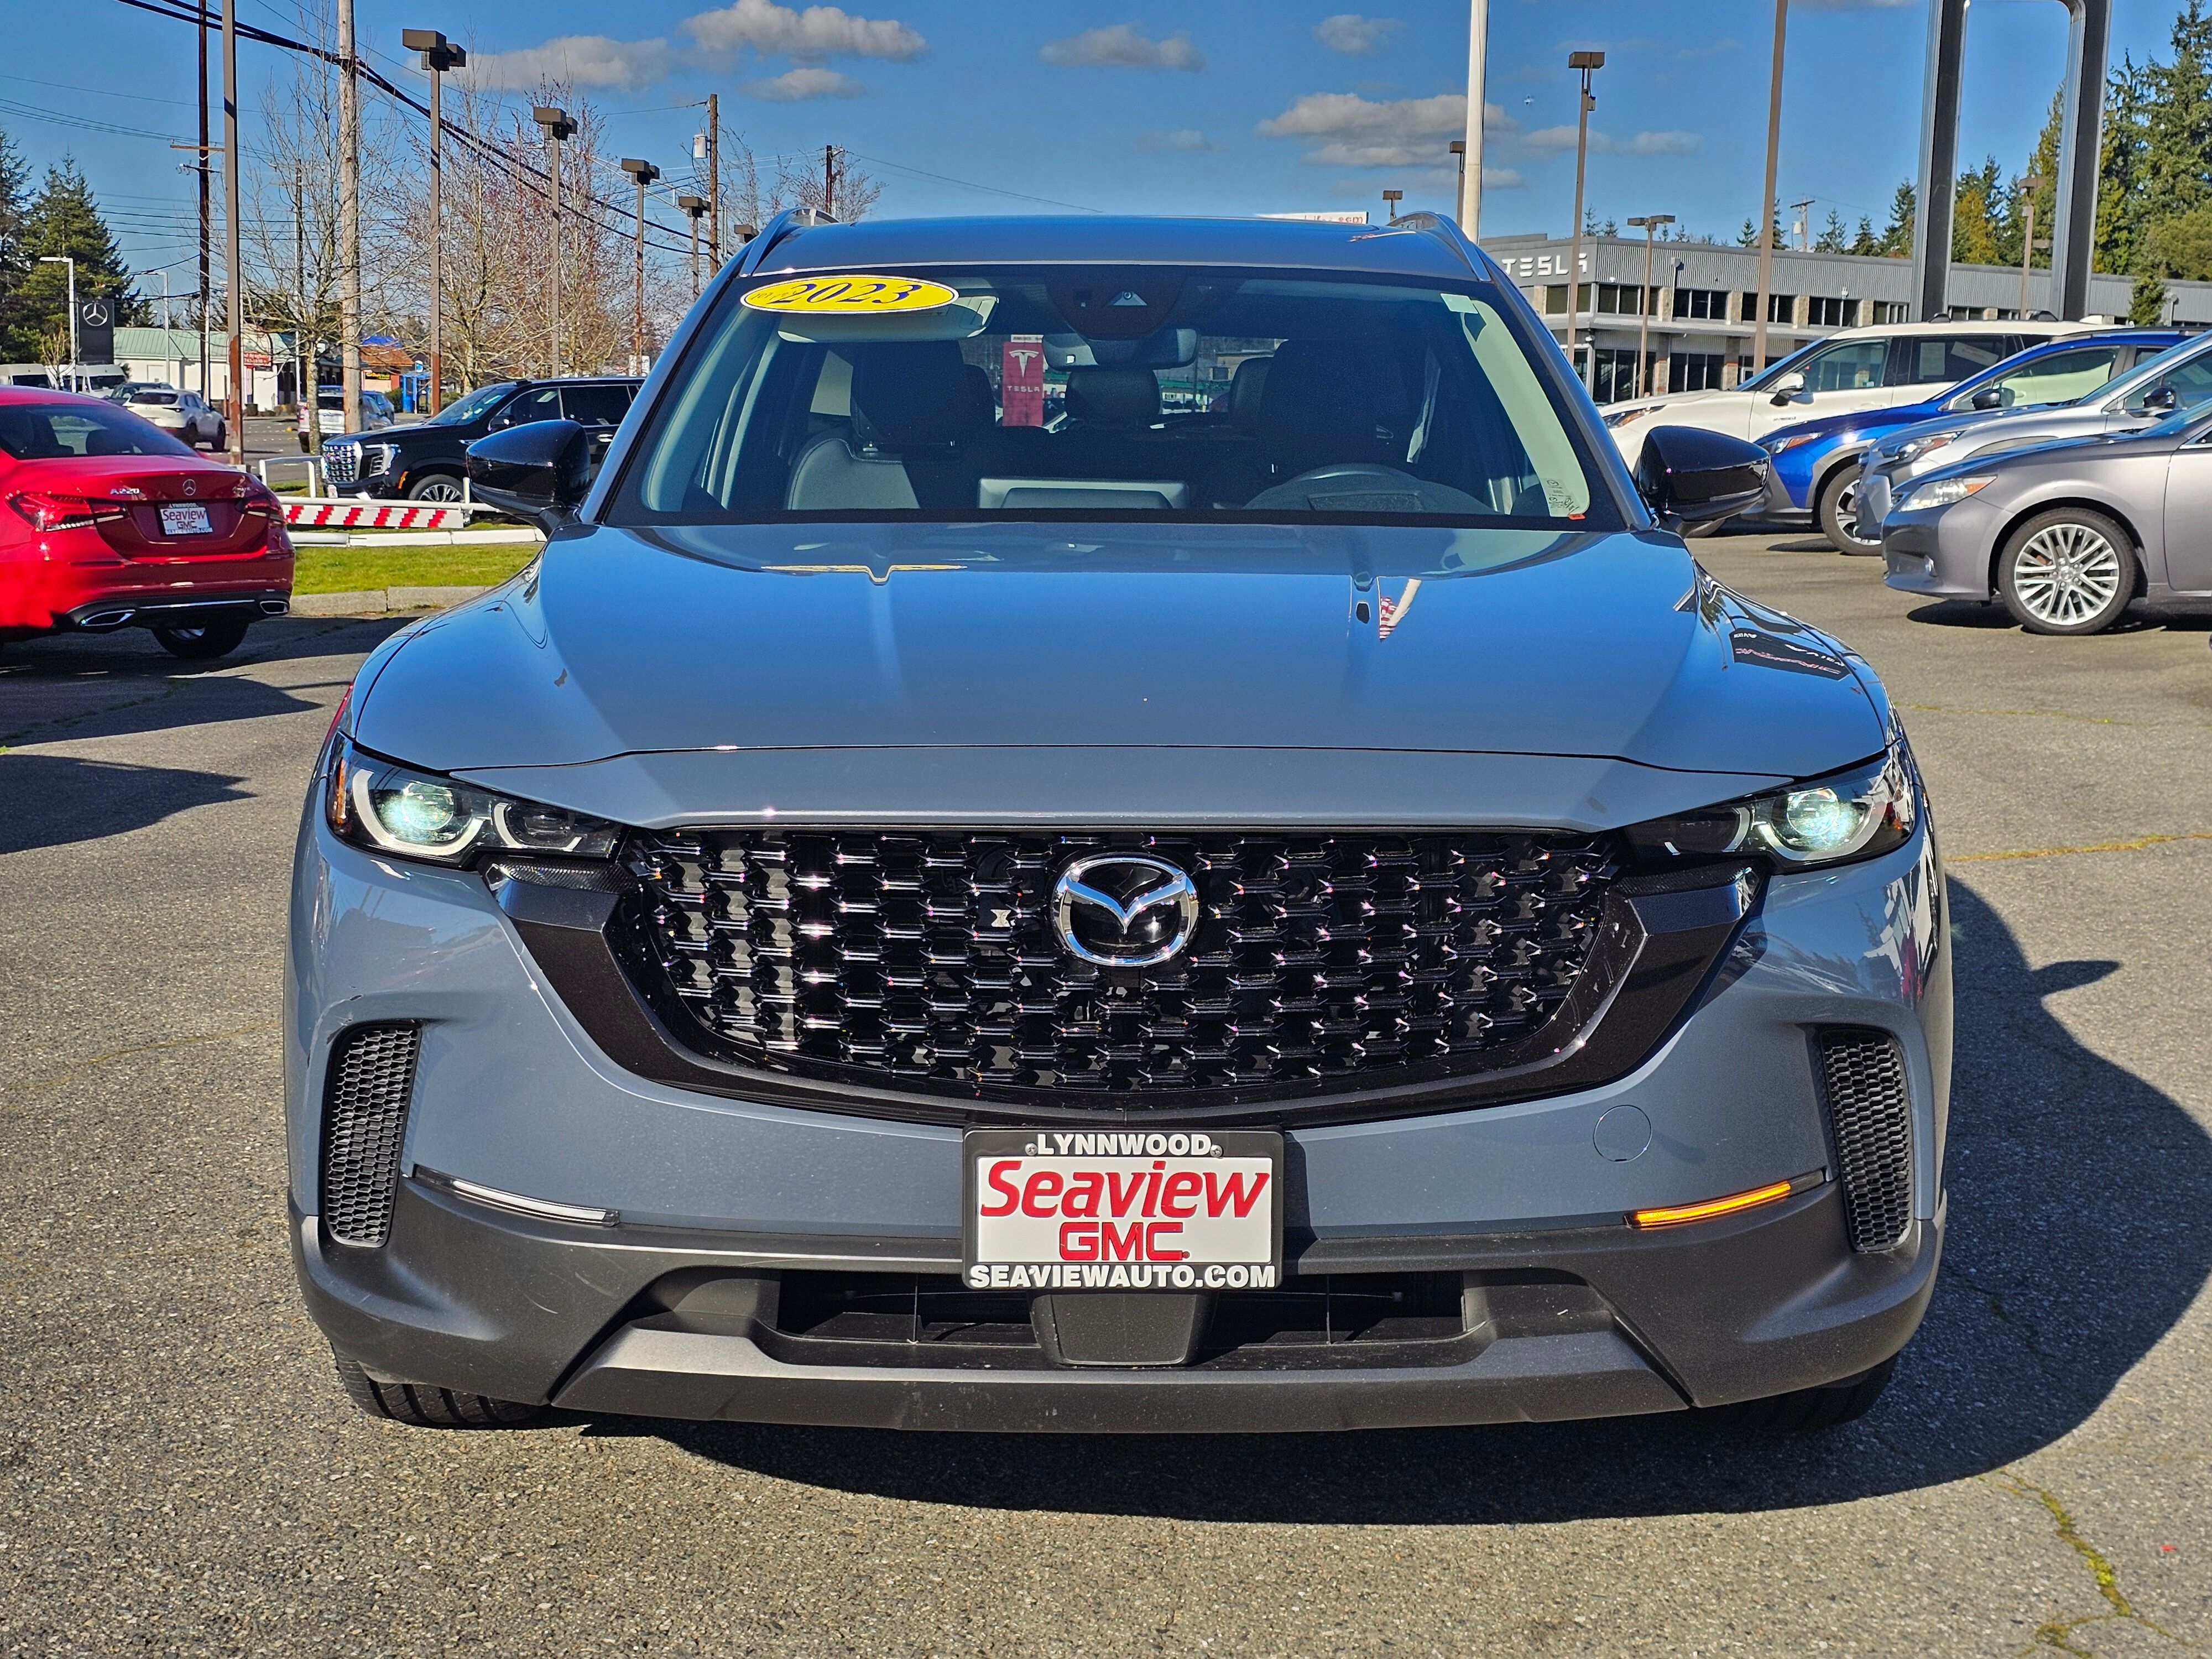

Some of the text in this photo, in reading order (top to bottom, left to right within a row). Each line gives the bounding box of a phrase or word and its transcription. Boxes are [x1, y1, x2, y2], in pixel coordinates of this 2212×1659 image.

[1501, 253, 1588, 278] TESLA
[766, 282, 923, 304] 2023
[163, 510, 206, 521] Seaview
[177, 520, 197, 530] GMC
[1037, 1134, 1211, 1156] LYNNWOOD
[980, 1160, 1270, 1218] Seaview
[1060, 1221, 1190, 1261] GMC
[969, 1265, 1275, 1288] SEAVIEWAUTO.COM
